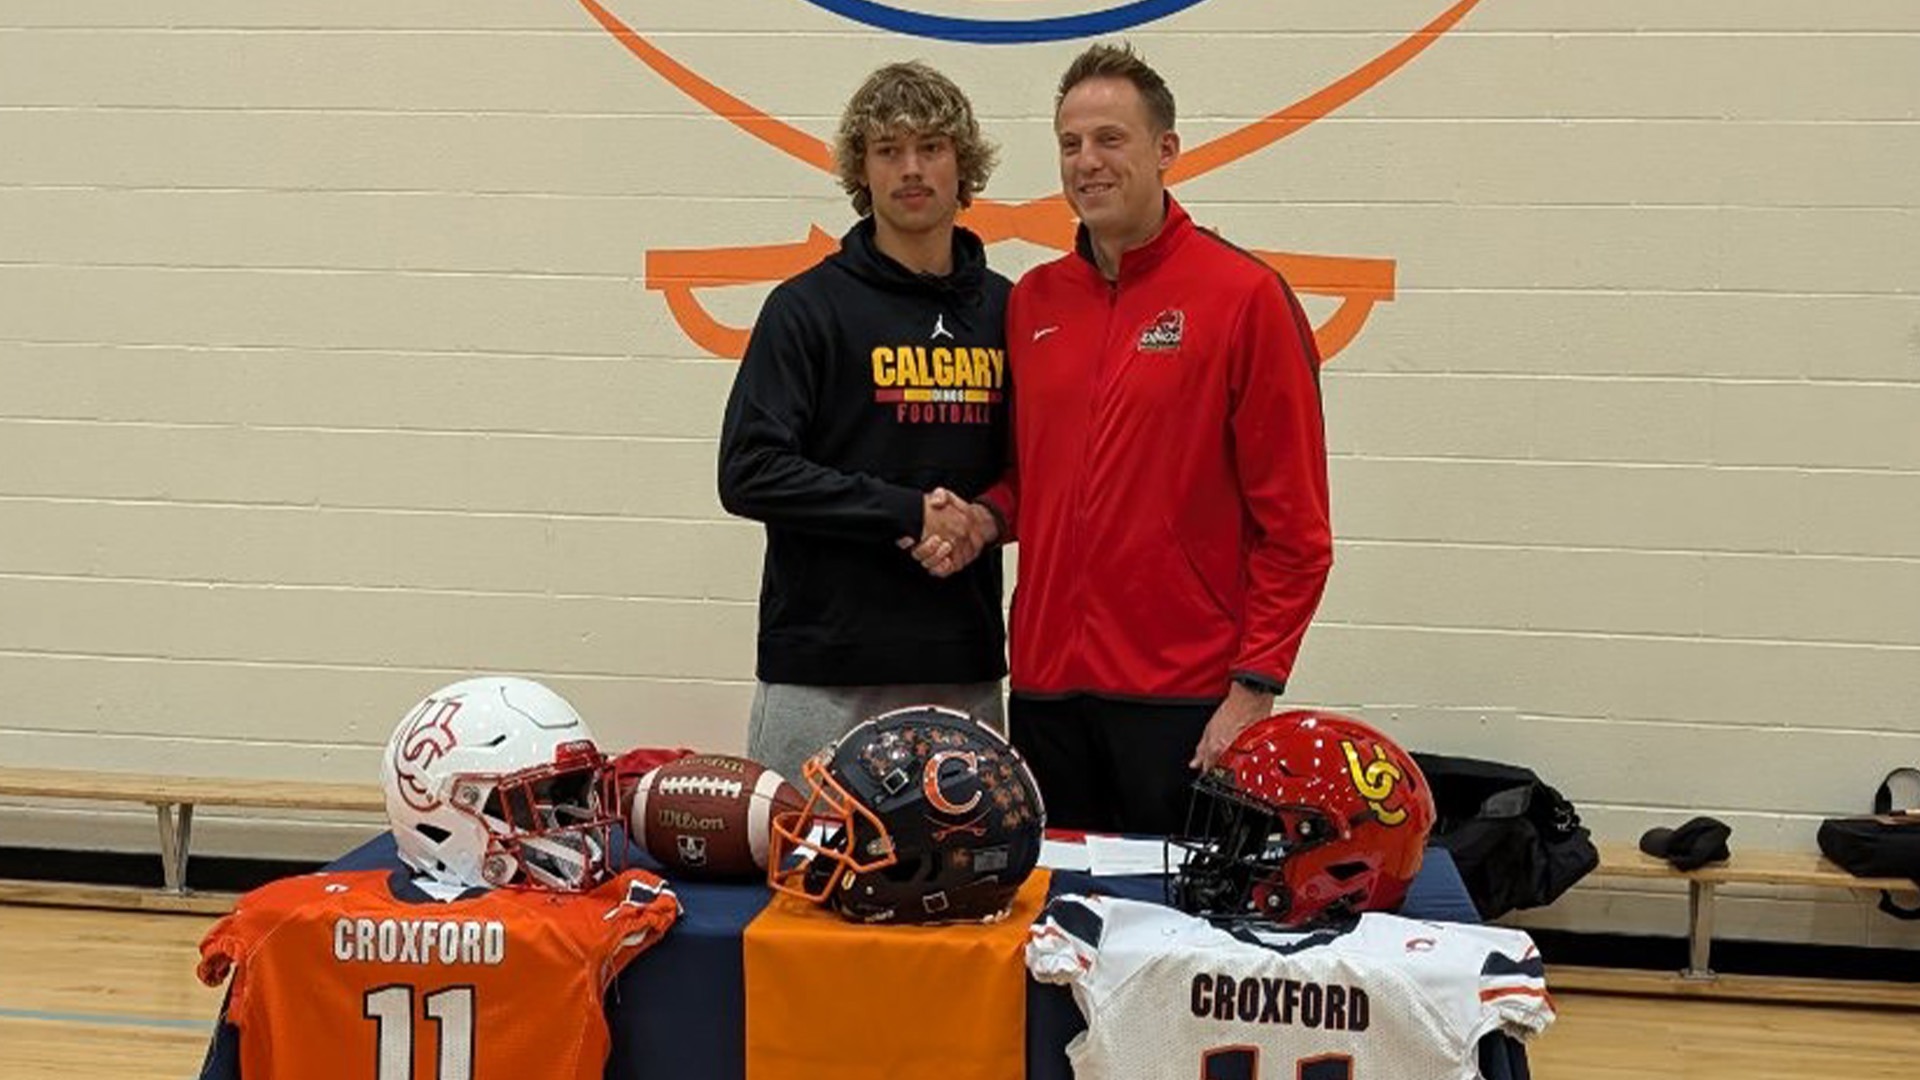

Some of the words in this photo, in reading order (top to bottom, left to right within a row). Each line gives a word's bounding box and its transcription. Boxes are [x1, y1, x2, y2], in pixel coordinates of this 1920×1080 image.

[871, 346, 1004, 389] CALGARY
[897, 403, 990, 423] FOOTBALL
[659, 809, 726, 831] Wilson
[333, 919, 506, 965] CROXFORD
[1190, 972, 1370, 1032] CROXFORD
[363, 983, 475, 1080] 11
